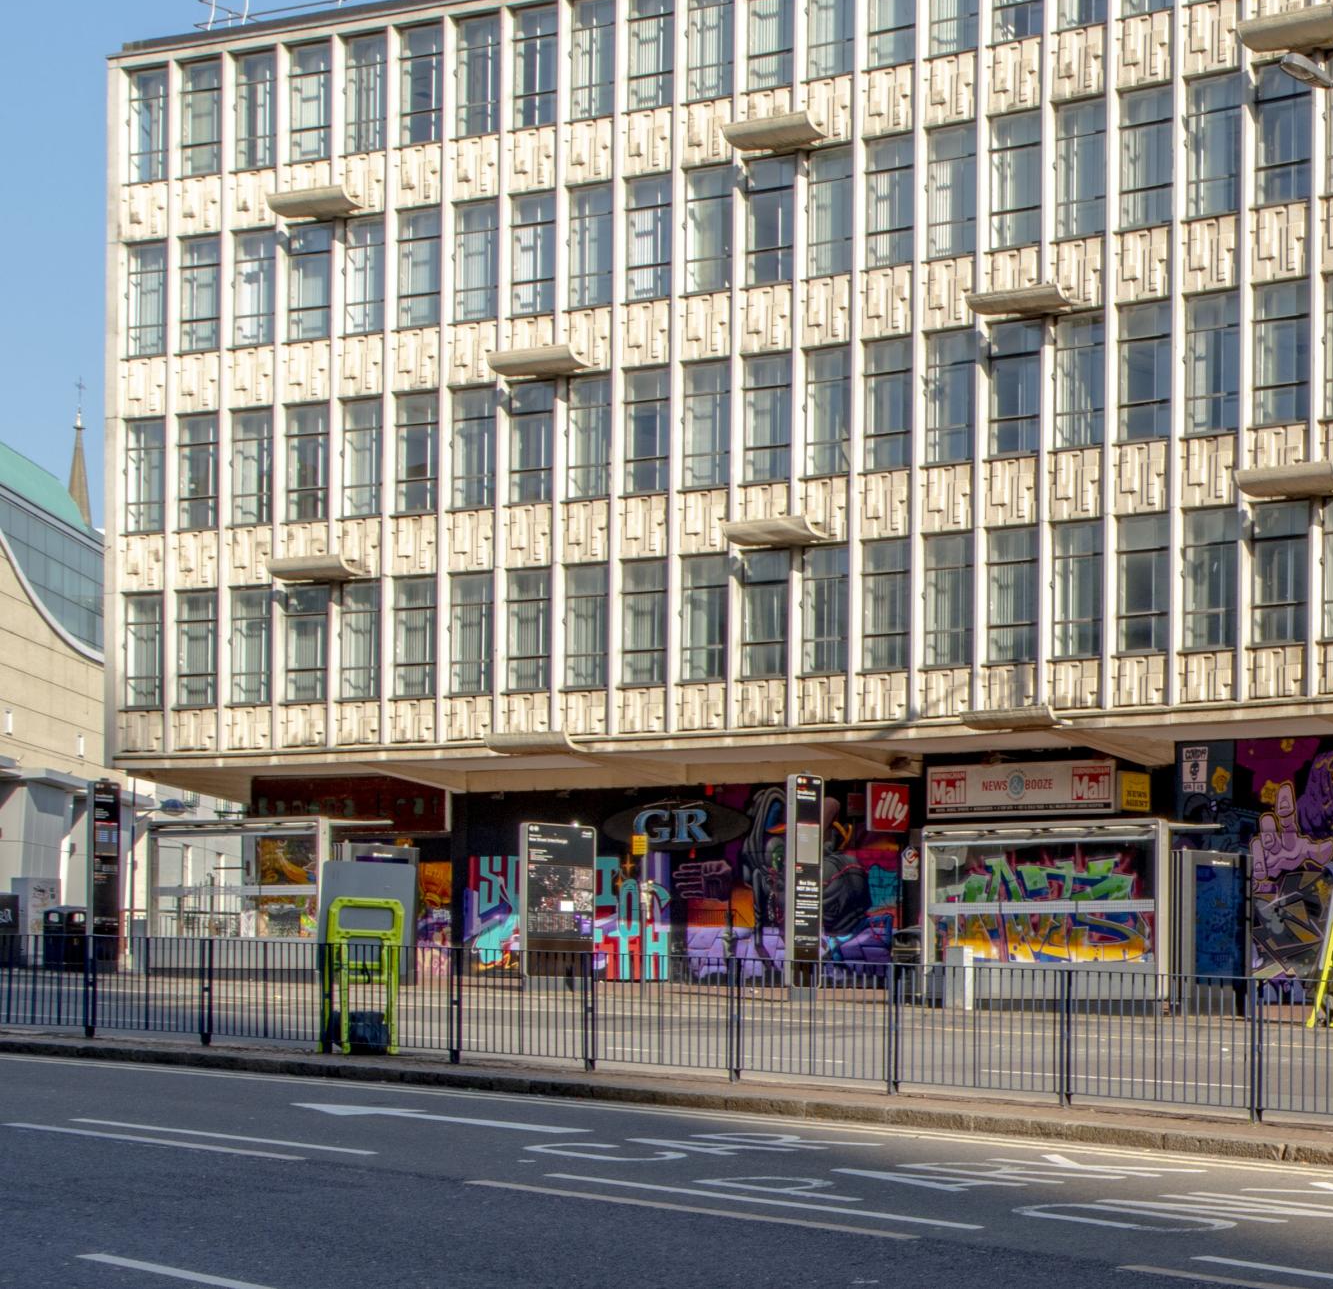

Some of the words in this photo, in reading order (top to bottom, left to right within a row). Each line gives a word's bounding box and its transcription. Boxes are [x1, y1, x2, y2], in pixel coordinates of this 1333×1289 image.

[931, 779, 965, 805] Mail
[981, 779, 1008, 791] NEWS
[1024, 778, 1054, 790] BOOZE
[1072, 774, 1110, 800] Mail
[875, 791, 909, 827] illy
[633, 808, 712, 844] GR
[523, 1132, 884, 1161] CAR
[693, 1154, 1208, 1201] PARK
